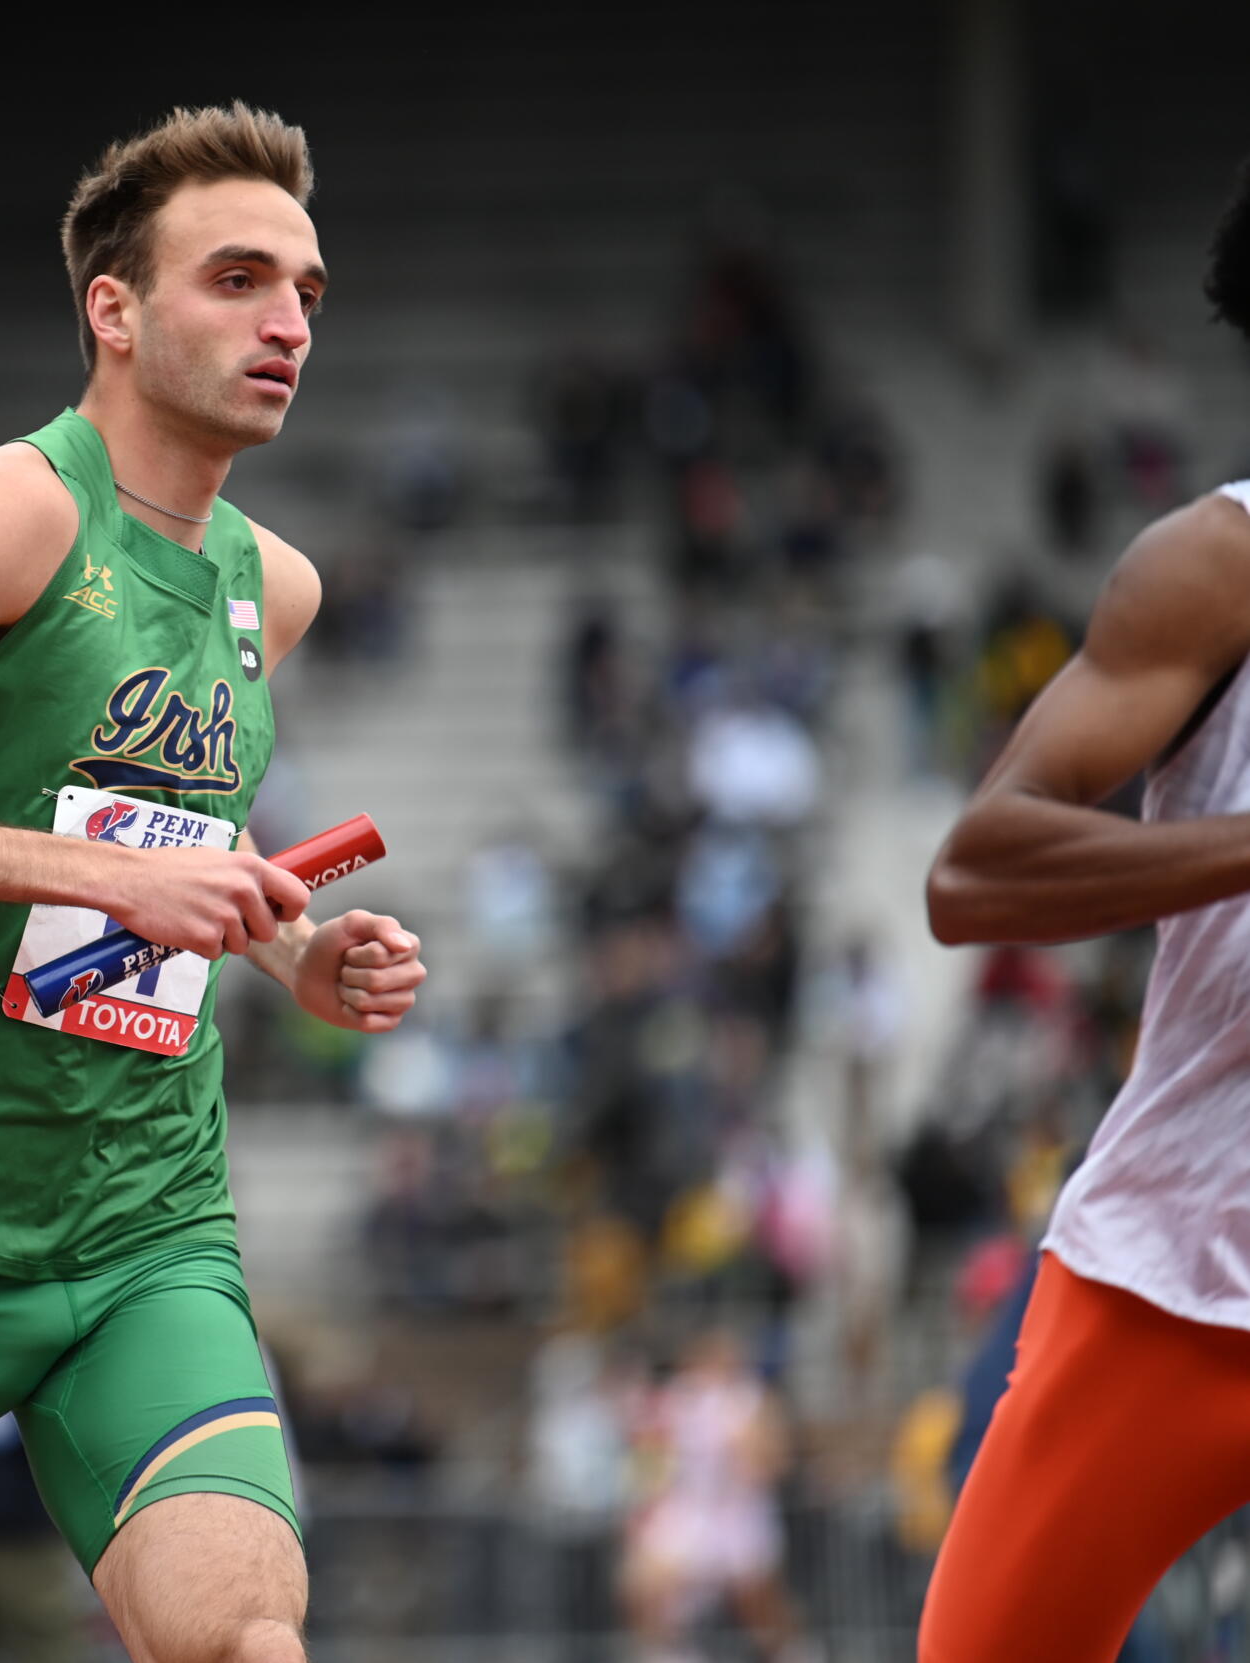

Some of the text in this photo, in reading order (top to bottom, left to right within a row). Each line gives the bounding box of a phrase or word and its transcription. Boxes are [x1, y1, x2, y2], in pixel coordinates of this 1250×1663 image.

[69, 586, 119, 617] ACC
[146, 811, 209, 841] PENN
[304, 854, 368, 890] YOTA
[122, 943, 176, 974] PEN
[78, 1000, 180, 1047] TOYOTA
